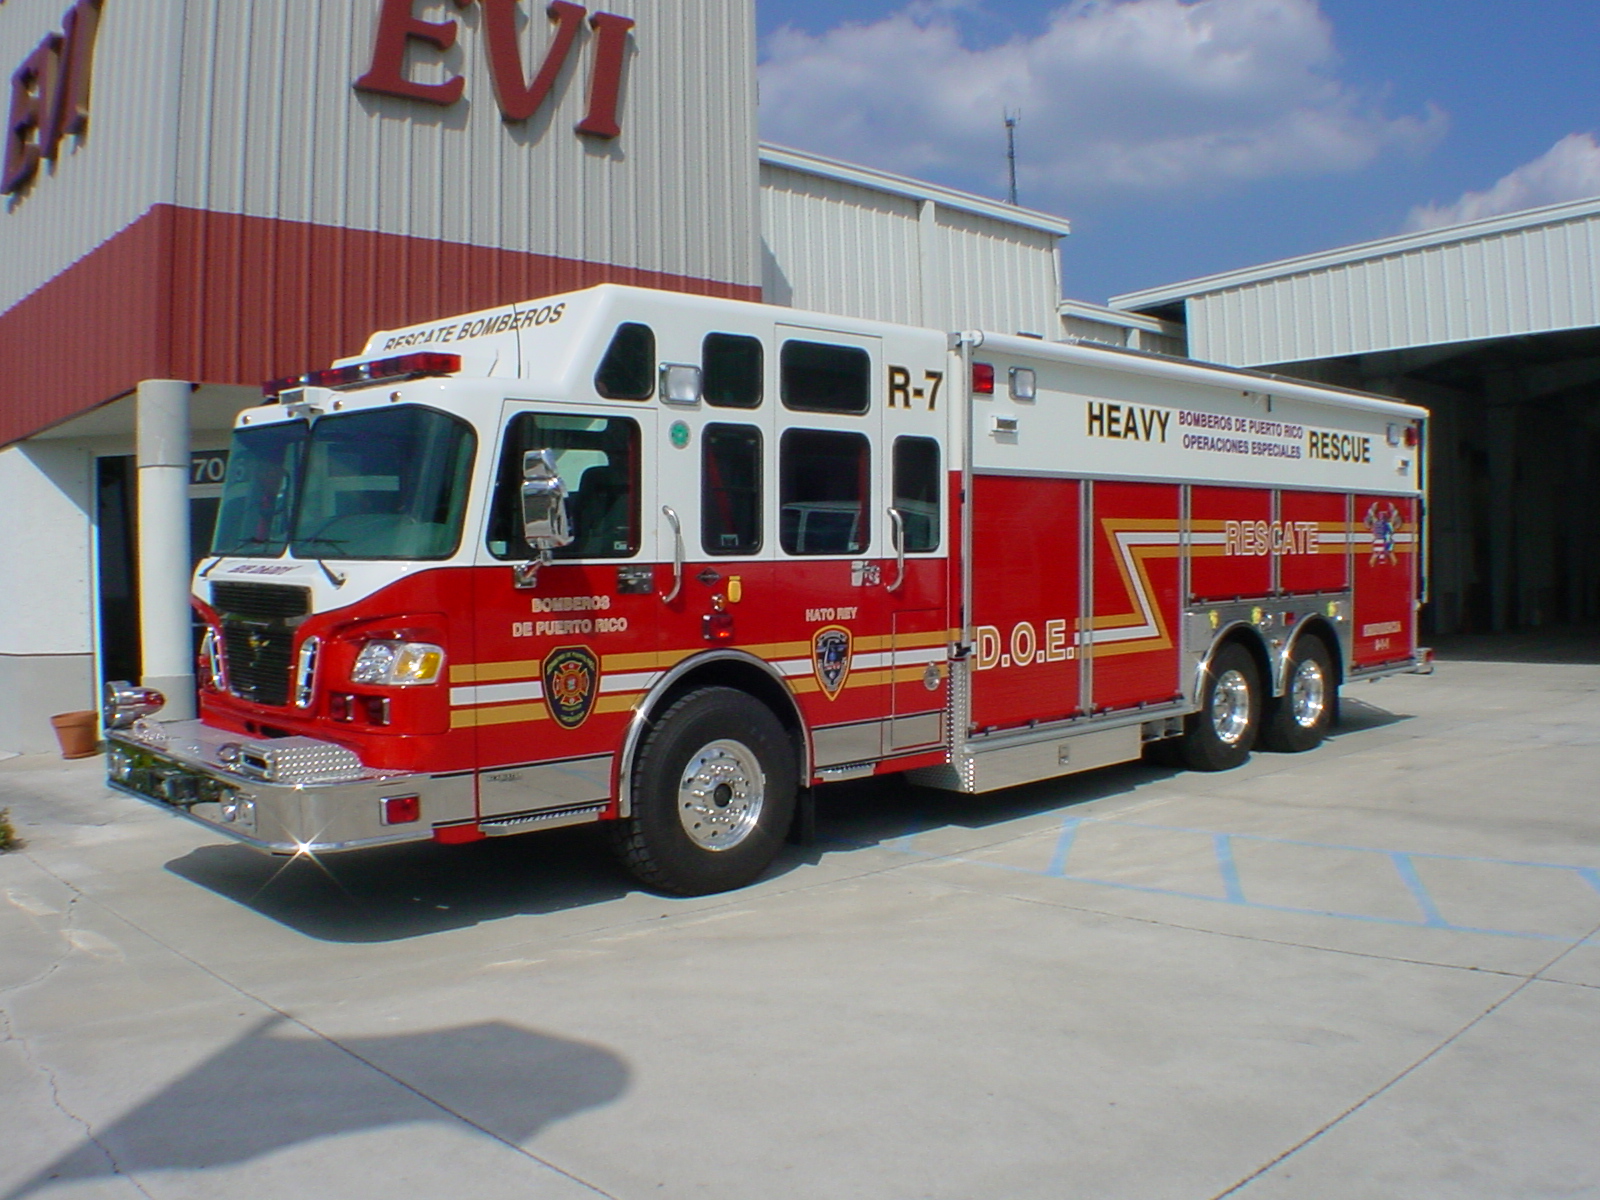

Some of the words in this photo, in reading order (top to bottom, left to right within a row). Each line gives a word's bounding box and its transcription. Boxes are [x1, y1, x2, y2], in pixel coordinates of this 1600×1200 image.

[352, 0, 635, 140] EVI
[383, 325, 457, 351] RESCATE
[456, 303, 565, 341] BOMBEROS
[887, 364, 943, 411] R-7
[1087, 401, 1171, 443] HEAVY
[1178, 411, 1233, 431] BOMBEROS
[1234, 418, 1247, 433] DE
[1248, 420, 1283, 437] PUERTO
[1283, 425, 1303, 440] RICO
[1183, 434, 1250, 455] OPERACIONES
[1251, 441, 1302, 460] ESPECIALES
[1309, 429, 1371, 464] RESCUE
[1225, 520, 1319, 556] RESCATE
[532, 595, 610, 613] BOMBEROS
[805, 608, 835, 622] HATO
[512, 622, 533, 637] DE
[535, 619, 592, 636] PUERTO
[594, 617, 628, 633] RICO
[976, 619, 1075, 670] D.O.E.
